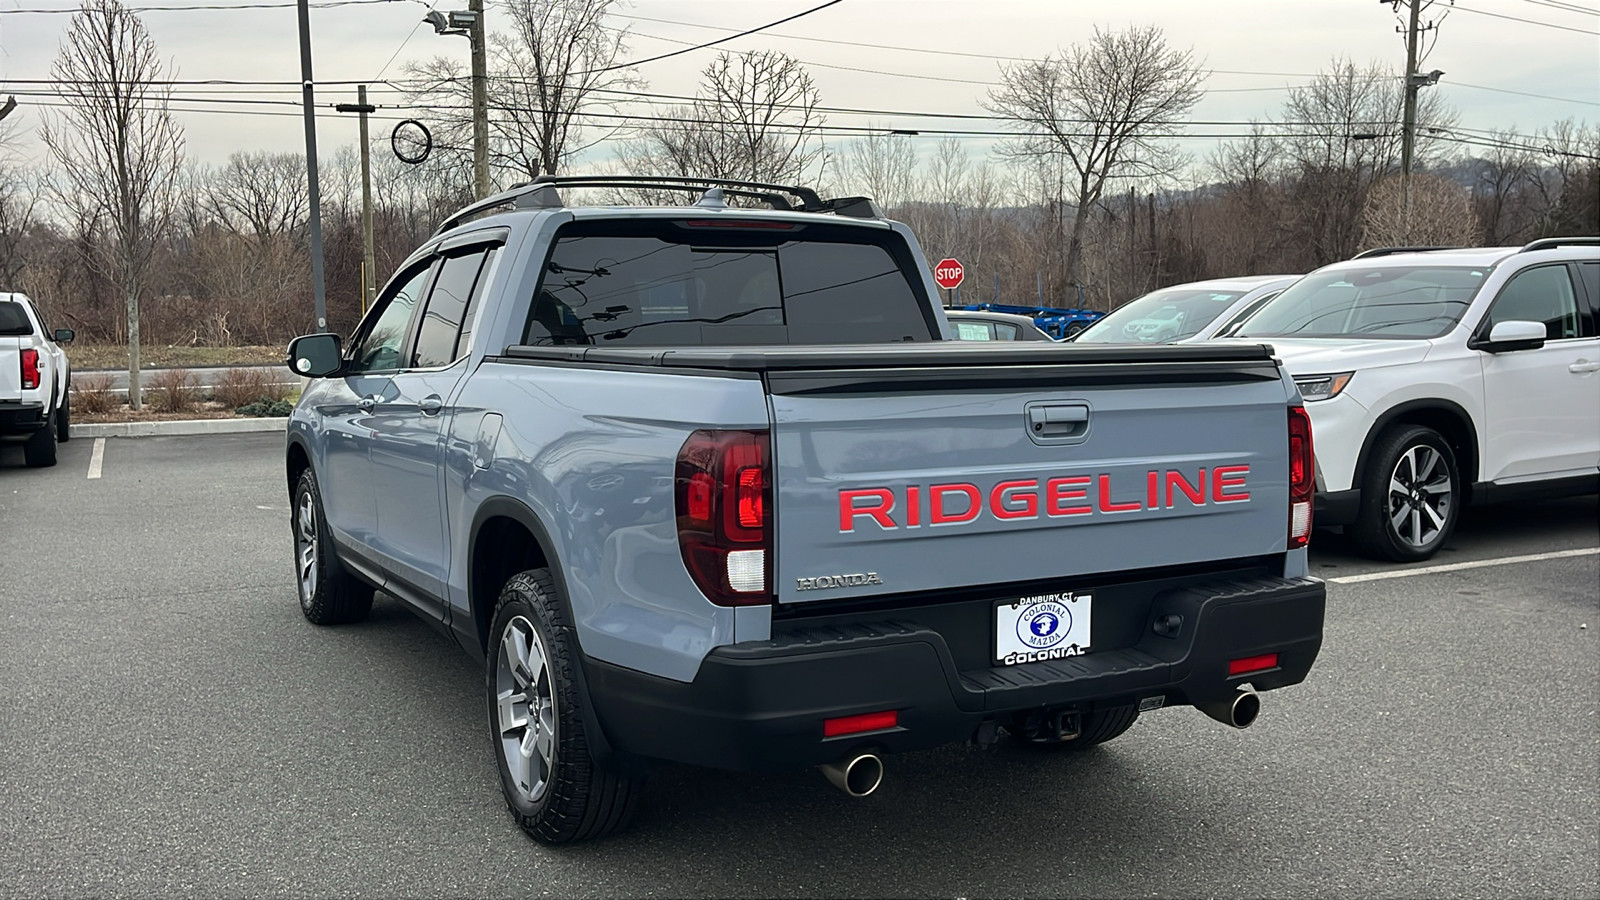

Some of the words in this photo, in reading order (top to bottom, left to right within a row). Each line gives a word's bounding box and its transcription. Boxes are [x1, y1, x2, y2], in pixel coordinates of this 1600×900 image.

[937, 267, 962, 280] STOP
[838, 464, 1251, 534] RIDGELINE
[796, 572, 883, 591] HONDA
[1020, 594, 1060, 605] DANBURY
[1062, 592, 1073, 600] CT
[1024, 604, 1065, 621] COLONIAL
[1028, 632, 1061, 646] MAZDA
[1004, 646, 1086, 666] COLONIAL
